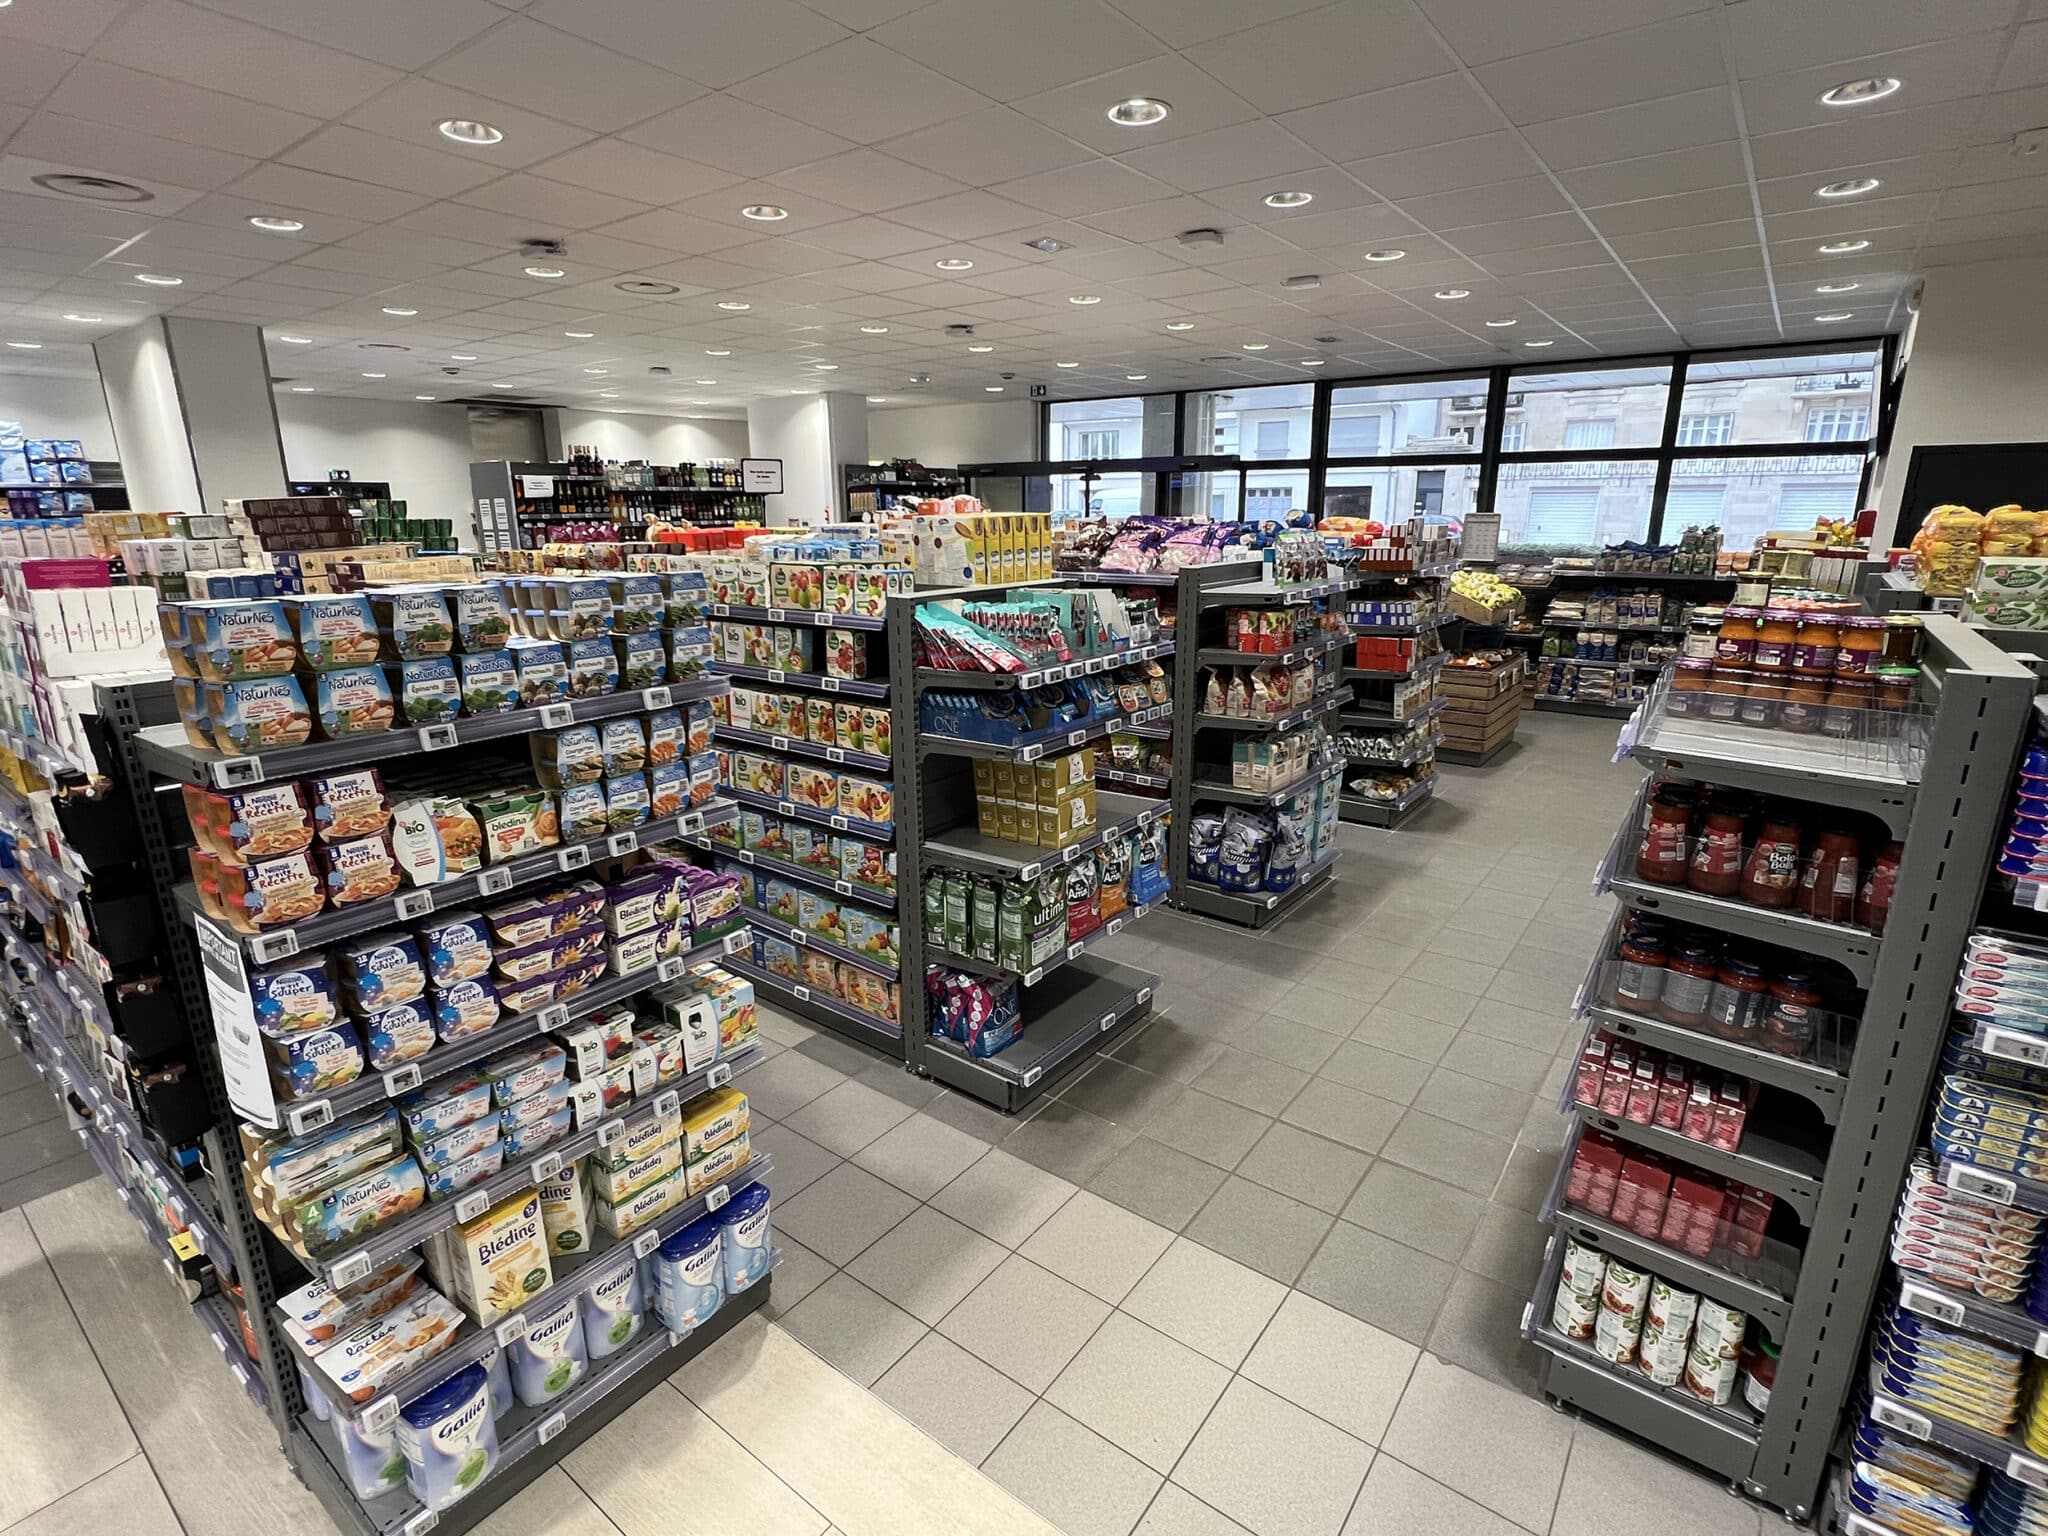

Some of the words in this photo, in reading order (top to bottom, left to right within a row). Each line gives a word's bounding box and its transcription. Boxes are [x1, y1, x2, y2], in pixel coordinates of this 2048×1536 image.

[218, 612, 275, 627] NaturNes
[311, 604, 362, 619] NaturNes
[328, 675, 377, 690] NaturNes
[235, 686, 291, 702] NaturNes
[934, 716, 960, 735] ONE
[330, 788, 372, 802] Recette
[246, 804, 293, 819] Recette
[341, 853, 382, 869] Recette
[260, 873, 305, 889] Recette
[443, 934, 475, 949] Souper
[371, 957, 405, 973] Souper
[270, 985, 312, 998] Souper
[449, 991, 481, 1006] Souper
[993, 1001, 1015, 1026] ONE
[383, 1016, 417, 1032] Souper
[305, 1042, 342, 1059] Souper
[628, 1124, 663, 1147] Blédidej
[628, 1155, 663, 1179] Blédidej
[340, 1179, 391, 1207] NaturNes
[541, 1184, 572, 1200] dine
[633, 1190, 667, 1215] Blédidej
[739, 1209, 769, 1237] Gallia
[479, 1221, 537, 1259] Blédine
[684, 1244, 719, 1274] Gallia
[596, 1265, 635, 1297] Gallia
[530, 1310, 574, 1343] Gallia
[438, 1397, 486, 1440] Gallia
